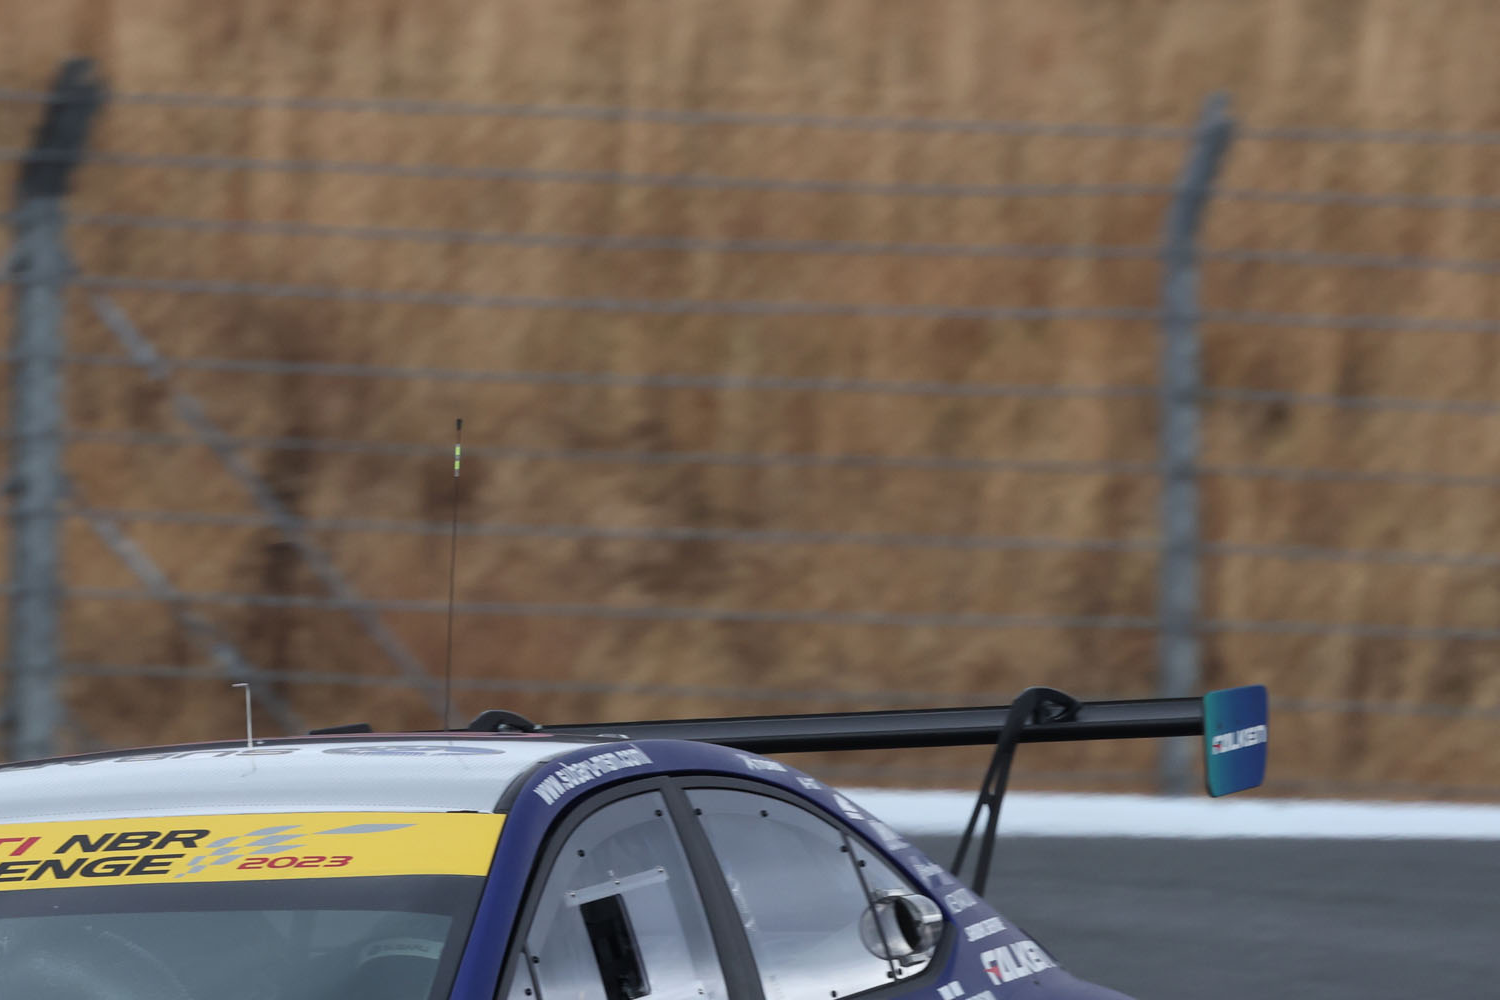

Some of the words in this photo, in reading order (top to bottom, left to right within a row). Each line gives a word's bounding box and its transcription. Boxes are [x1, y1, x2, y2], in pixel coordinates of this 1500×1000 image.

[1212, 724, 1267, 755] FALKEN
[55, 828, 211, 855] NBR
[236, 855, 355, 871] 2023
